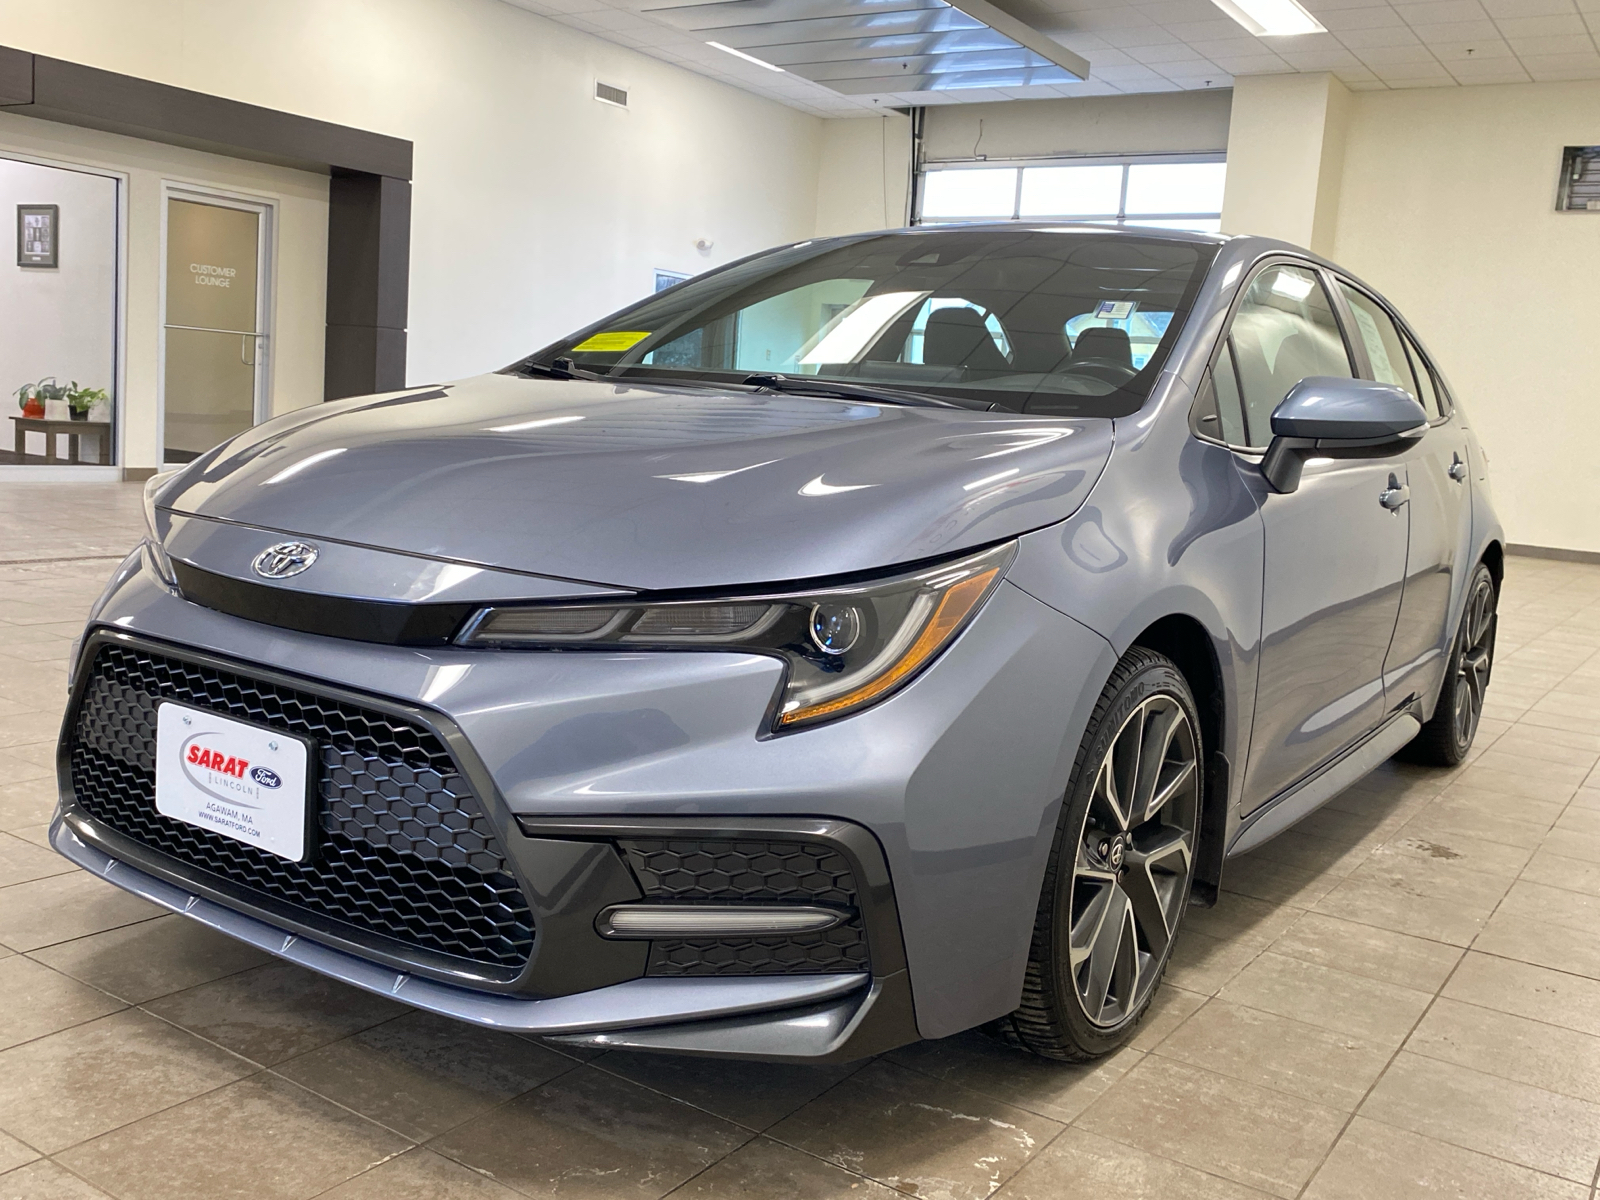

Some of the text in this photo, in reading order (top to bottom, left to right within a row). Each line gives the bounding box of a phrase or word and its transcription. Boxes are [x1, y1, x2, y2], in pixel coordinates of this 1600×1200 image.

[190, 263, 236, 277] CUSTOMER
[195, 275, 230, 288] LOUNGE
[187, 744, 277, 787] SARAT Ford
[214, 776, 253, 795] LINCOLN
[198, 810, 261, 838] WWW.SARATFORD.COM
[206, 802, 254, 825] AGAWAM, MA
